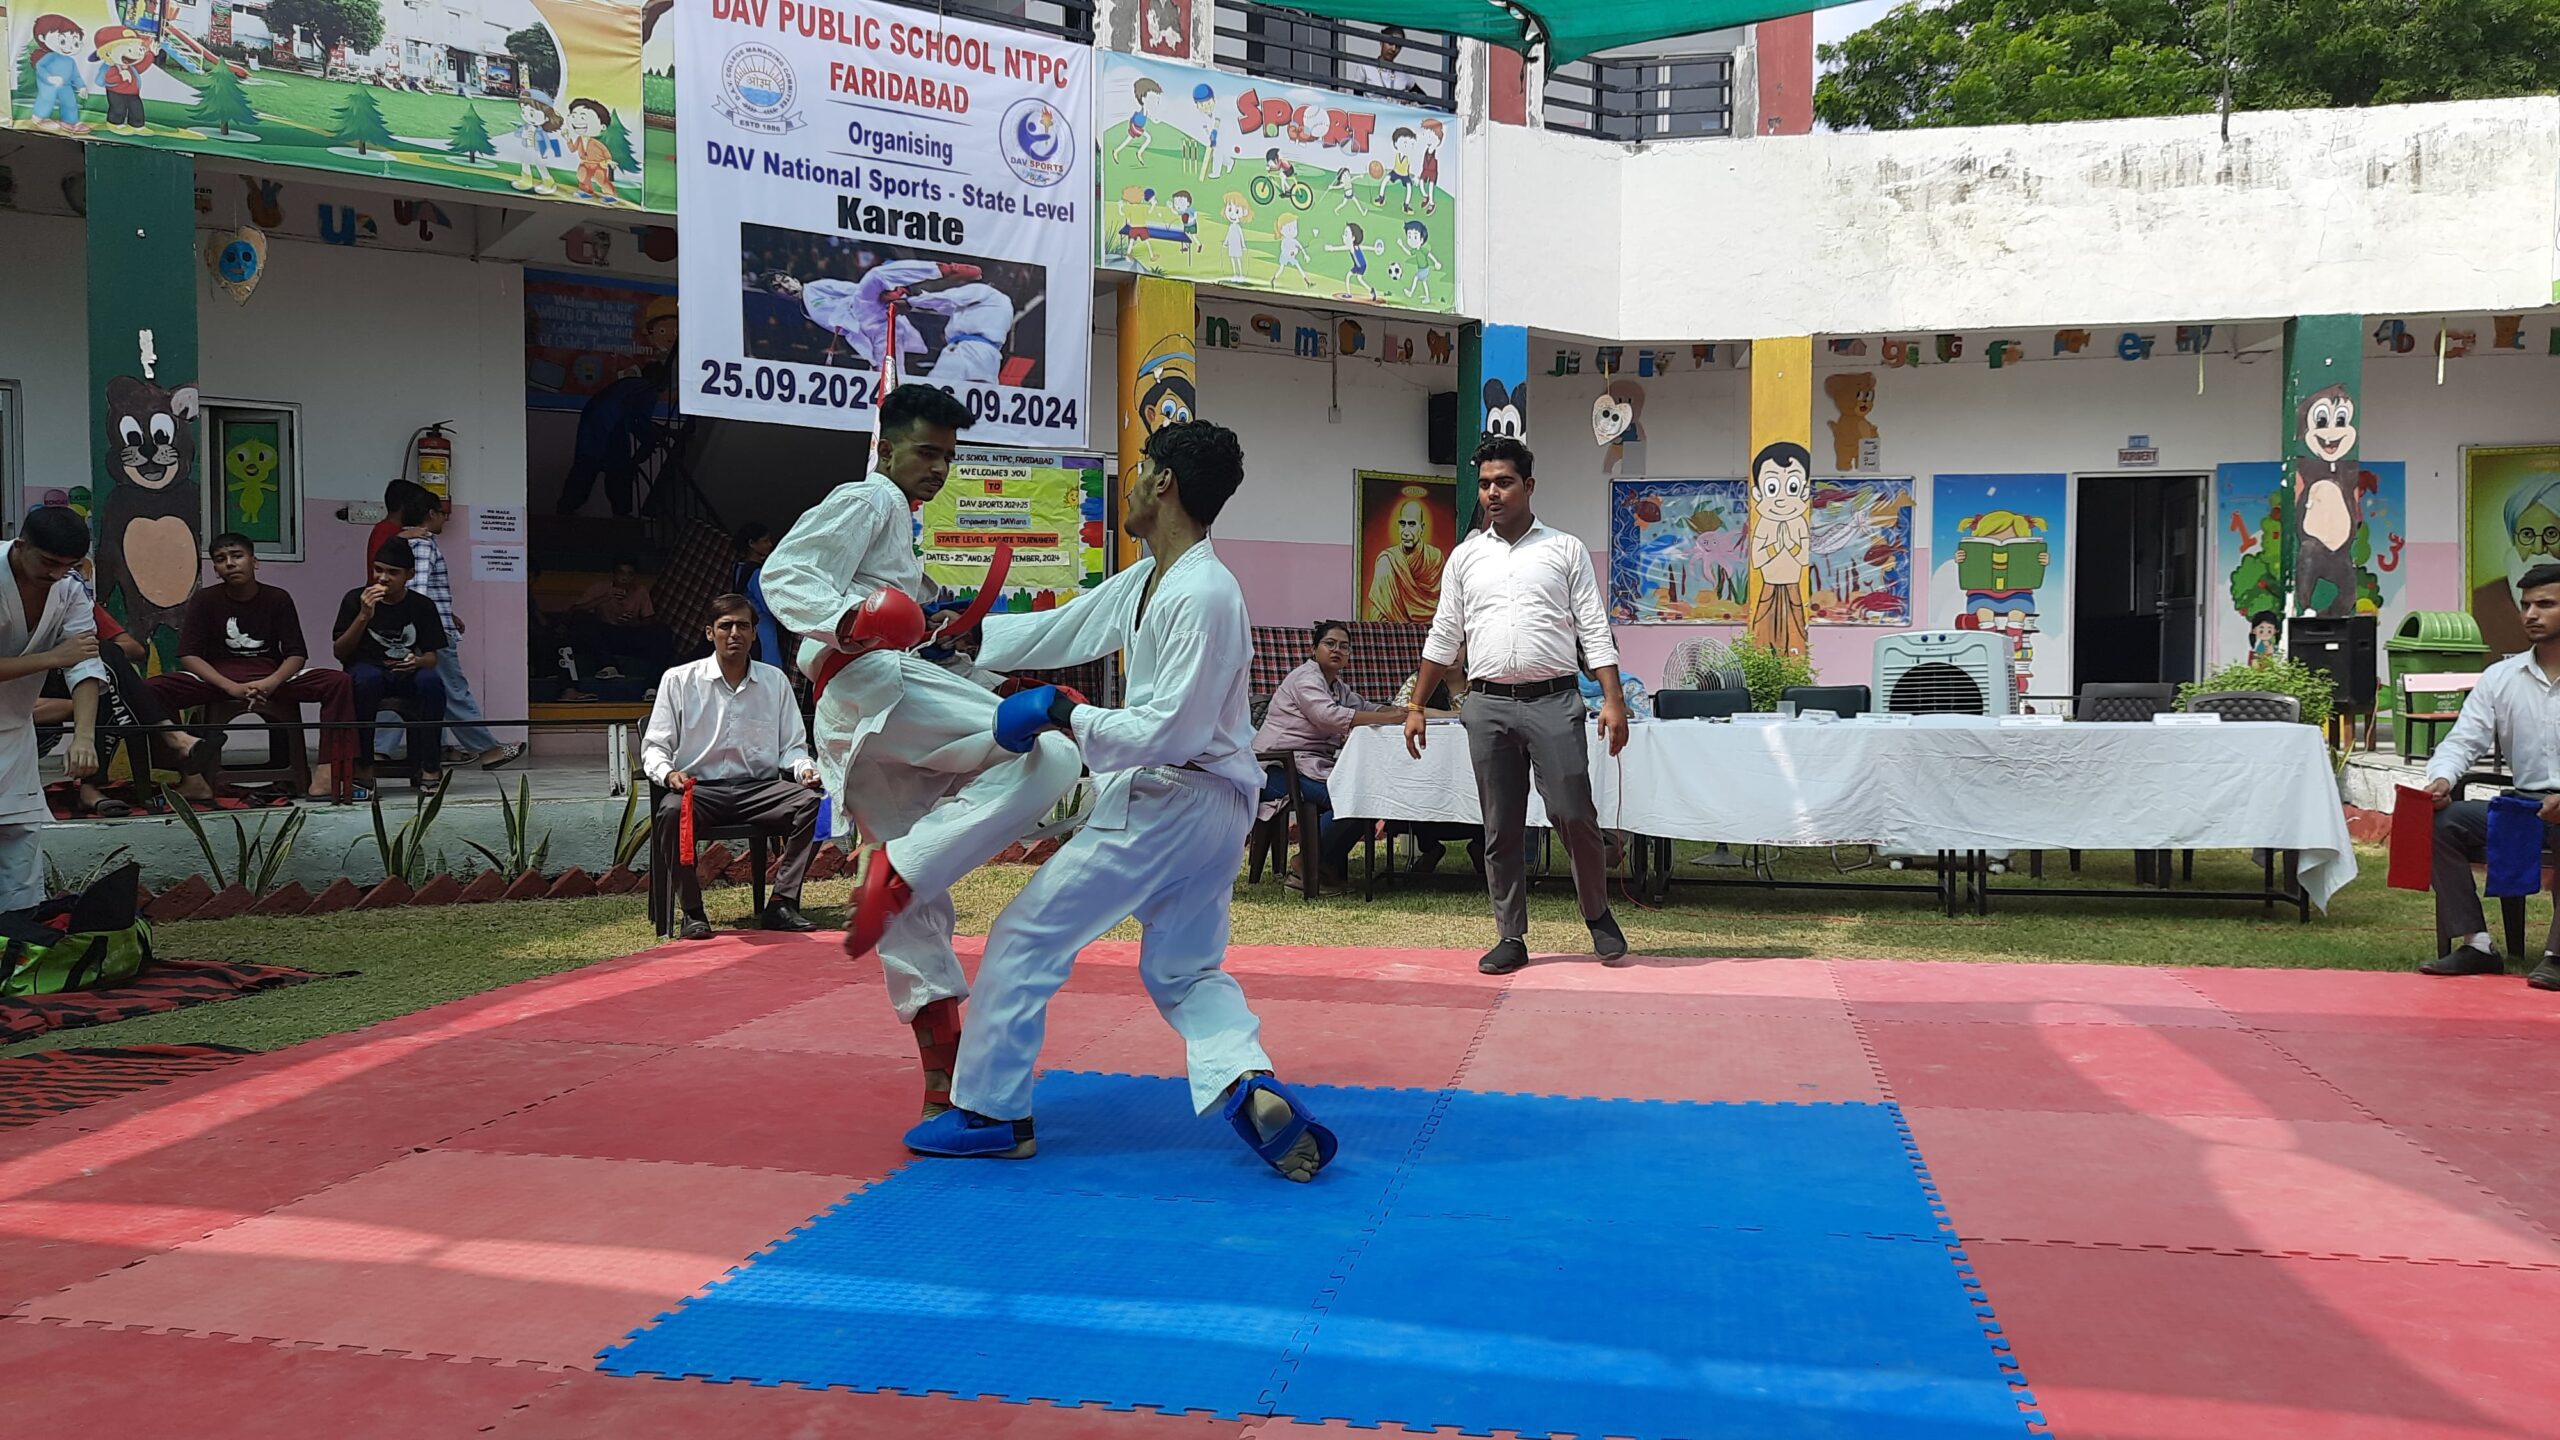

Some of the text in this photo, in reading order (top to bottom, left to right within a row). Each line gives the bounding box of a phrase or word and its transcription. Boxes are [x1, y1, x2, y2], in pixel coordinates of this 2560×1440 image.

[712, 0, 1069, 89] DAV PUBLIC SCHOOL NTPC
[726, 49, 745, 78] COLLEGE
[745, 46, 785, 67] MANAGING
[779, 67, 793, 109] COMMITTEE
[830, 61, 970, 114] FARIDABAD
[739, 119, 760, 129] ESTD
[1236, 87, 1376, 153] SPORT
[848, 121, 954, 165] Organising
[1010, 156, 1028, 166] DAV
[1029, 160, 1064, 173] SPORTS
[707, 140, 755, 171] DAV
[763, 151, 861, 189] National
[868, 168, 943, 202] Sports
[962, 183, 1017, 213] State
[1022, 196, 1075, 223] Level
[837, 194, 965, 246] Karate
[592, 311, 633, 326] MAKING
[701, 359, 881, 410] 25.09.2024
[966, 453, 989, 462] SCHOOL
[959, 467, 1008, 478] WELCOMES
[988, 482, 1000, 490] TO
[959, 499, 977, 508] DAV
[978, 500, 1004, 509] SPORTS
[959, 517, 1027, 527] Empowering DAVians
[2229, 510, 2257, 553] 1
[936, 535, 961, 544] STATE
[962, 536, 985, 544] LEVEL
[1016, 536, 1057, 544] TOURNAMENT
[2377, 532, 2405, 572] 3
[925, 553, 950, 561] DATES
[968, 555, 982, 563] AND
[1011, 555, 1042, 563] TEMBER,
